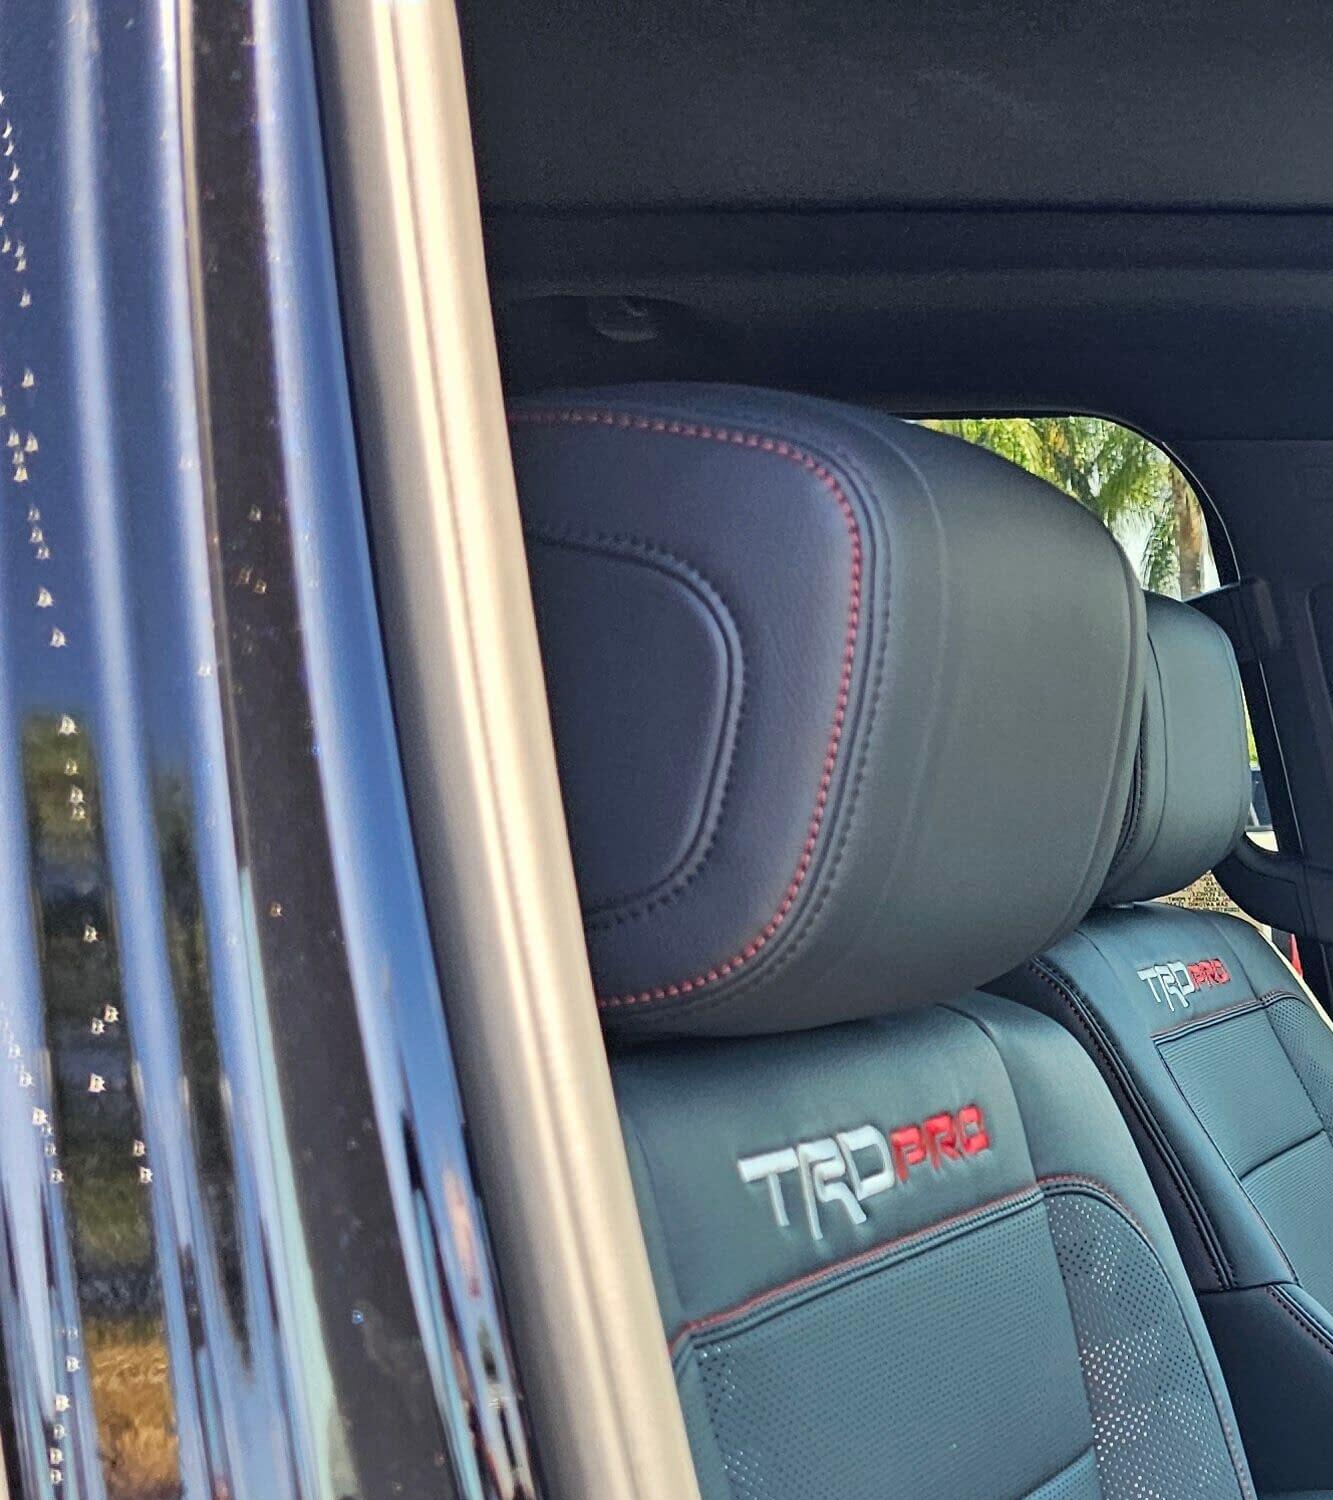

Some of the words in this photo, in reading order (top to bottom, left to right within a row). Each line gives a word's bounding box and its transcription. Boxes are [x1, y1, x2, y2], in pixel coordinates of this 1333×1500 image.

[1136, 960, 1195, 1012] TRD
[1190, 957, 1232, 990] PRO
[738, 1123, 895, 1240] TRD
[889, 1103, 991, 1183] PRO
